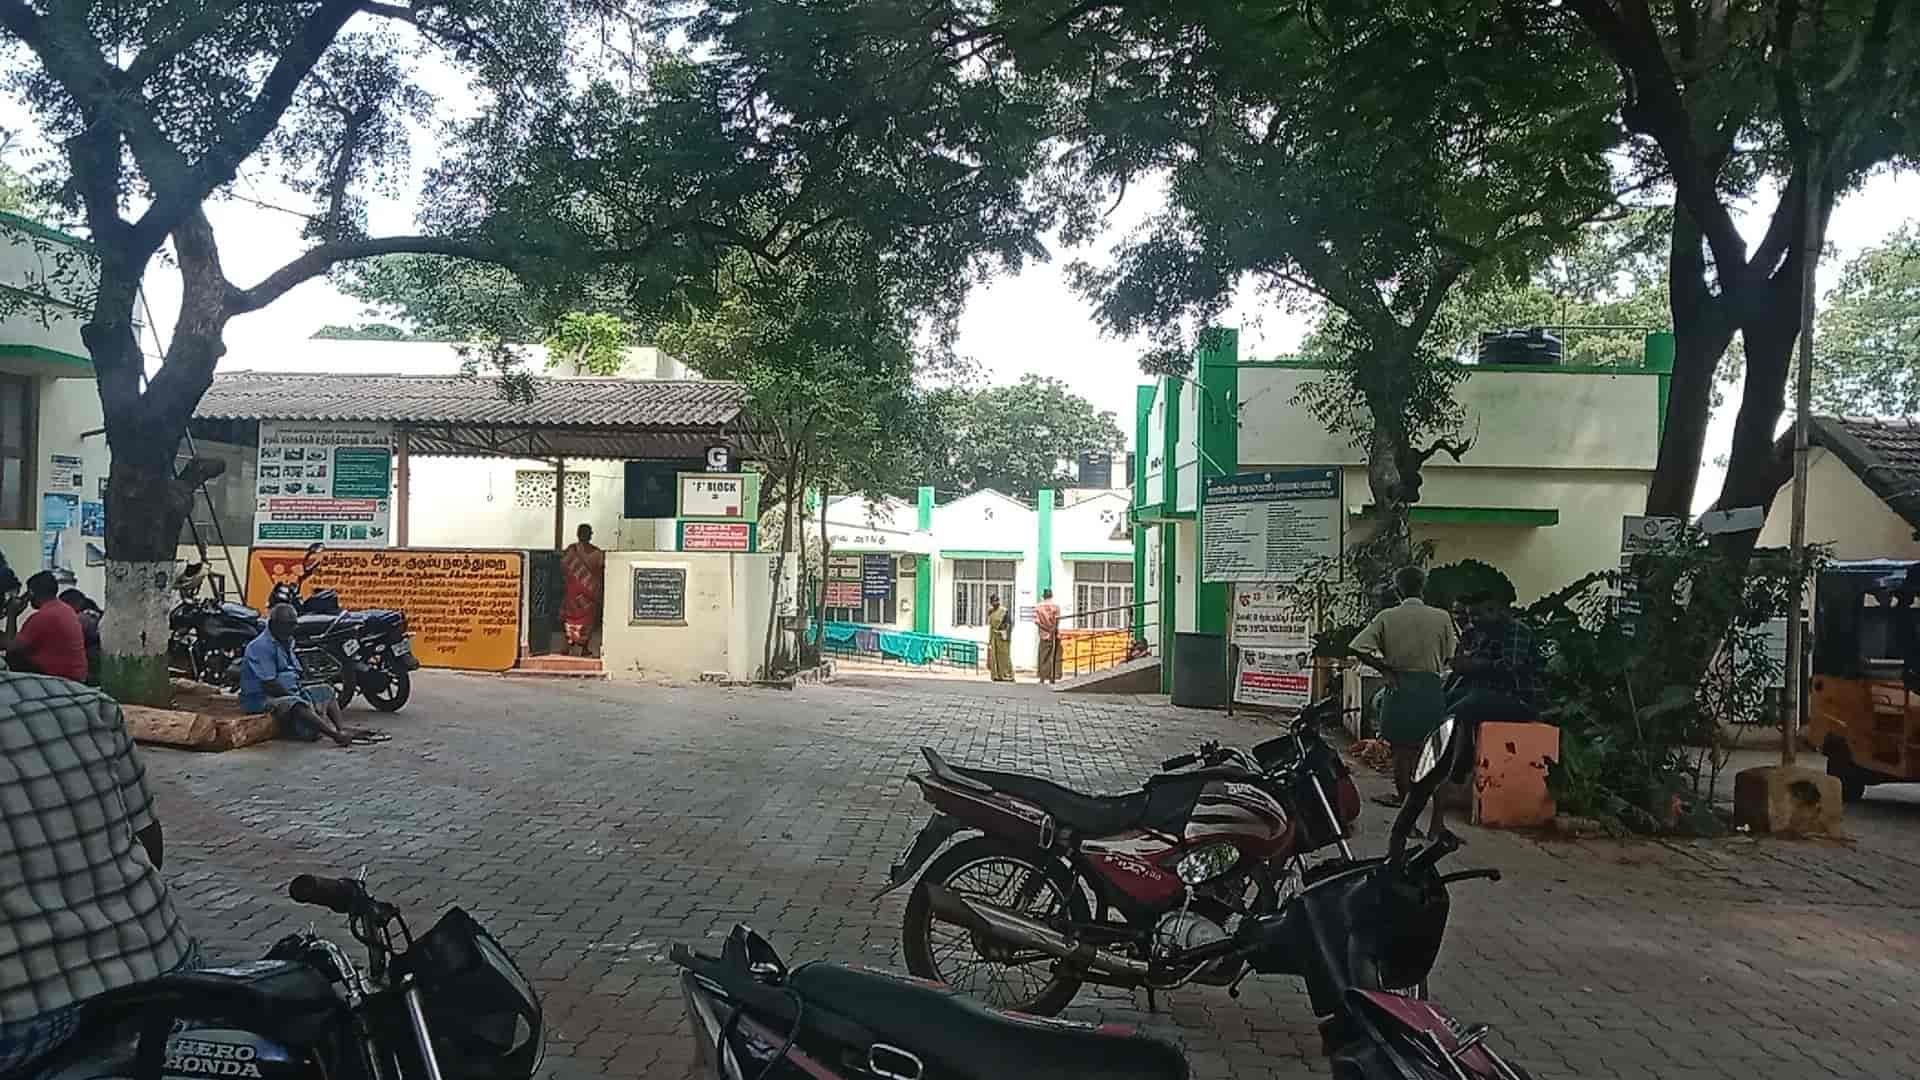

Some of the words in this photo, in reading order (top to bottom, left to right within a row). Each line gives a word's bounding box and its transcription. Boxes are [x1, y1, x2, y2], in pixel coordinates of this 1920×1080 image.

[707, 447, 728, 466] G
[707, 481, 737, 493] BLOCK
[371, 553, 400, 569] அரசு
[406, 554, 441, 570] குடும்ப
[175, 1039, 255, 1061] HERO
[161, 1055, 264, 1078] HONDA
